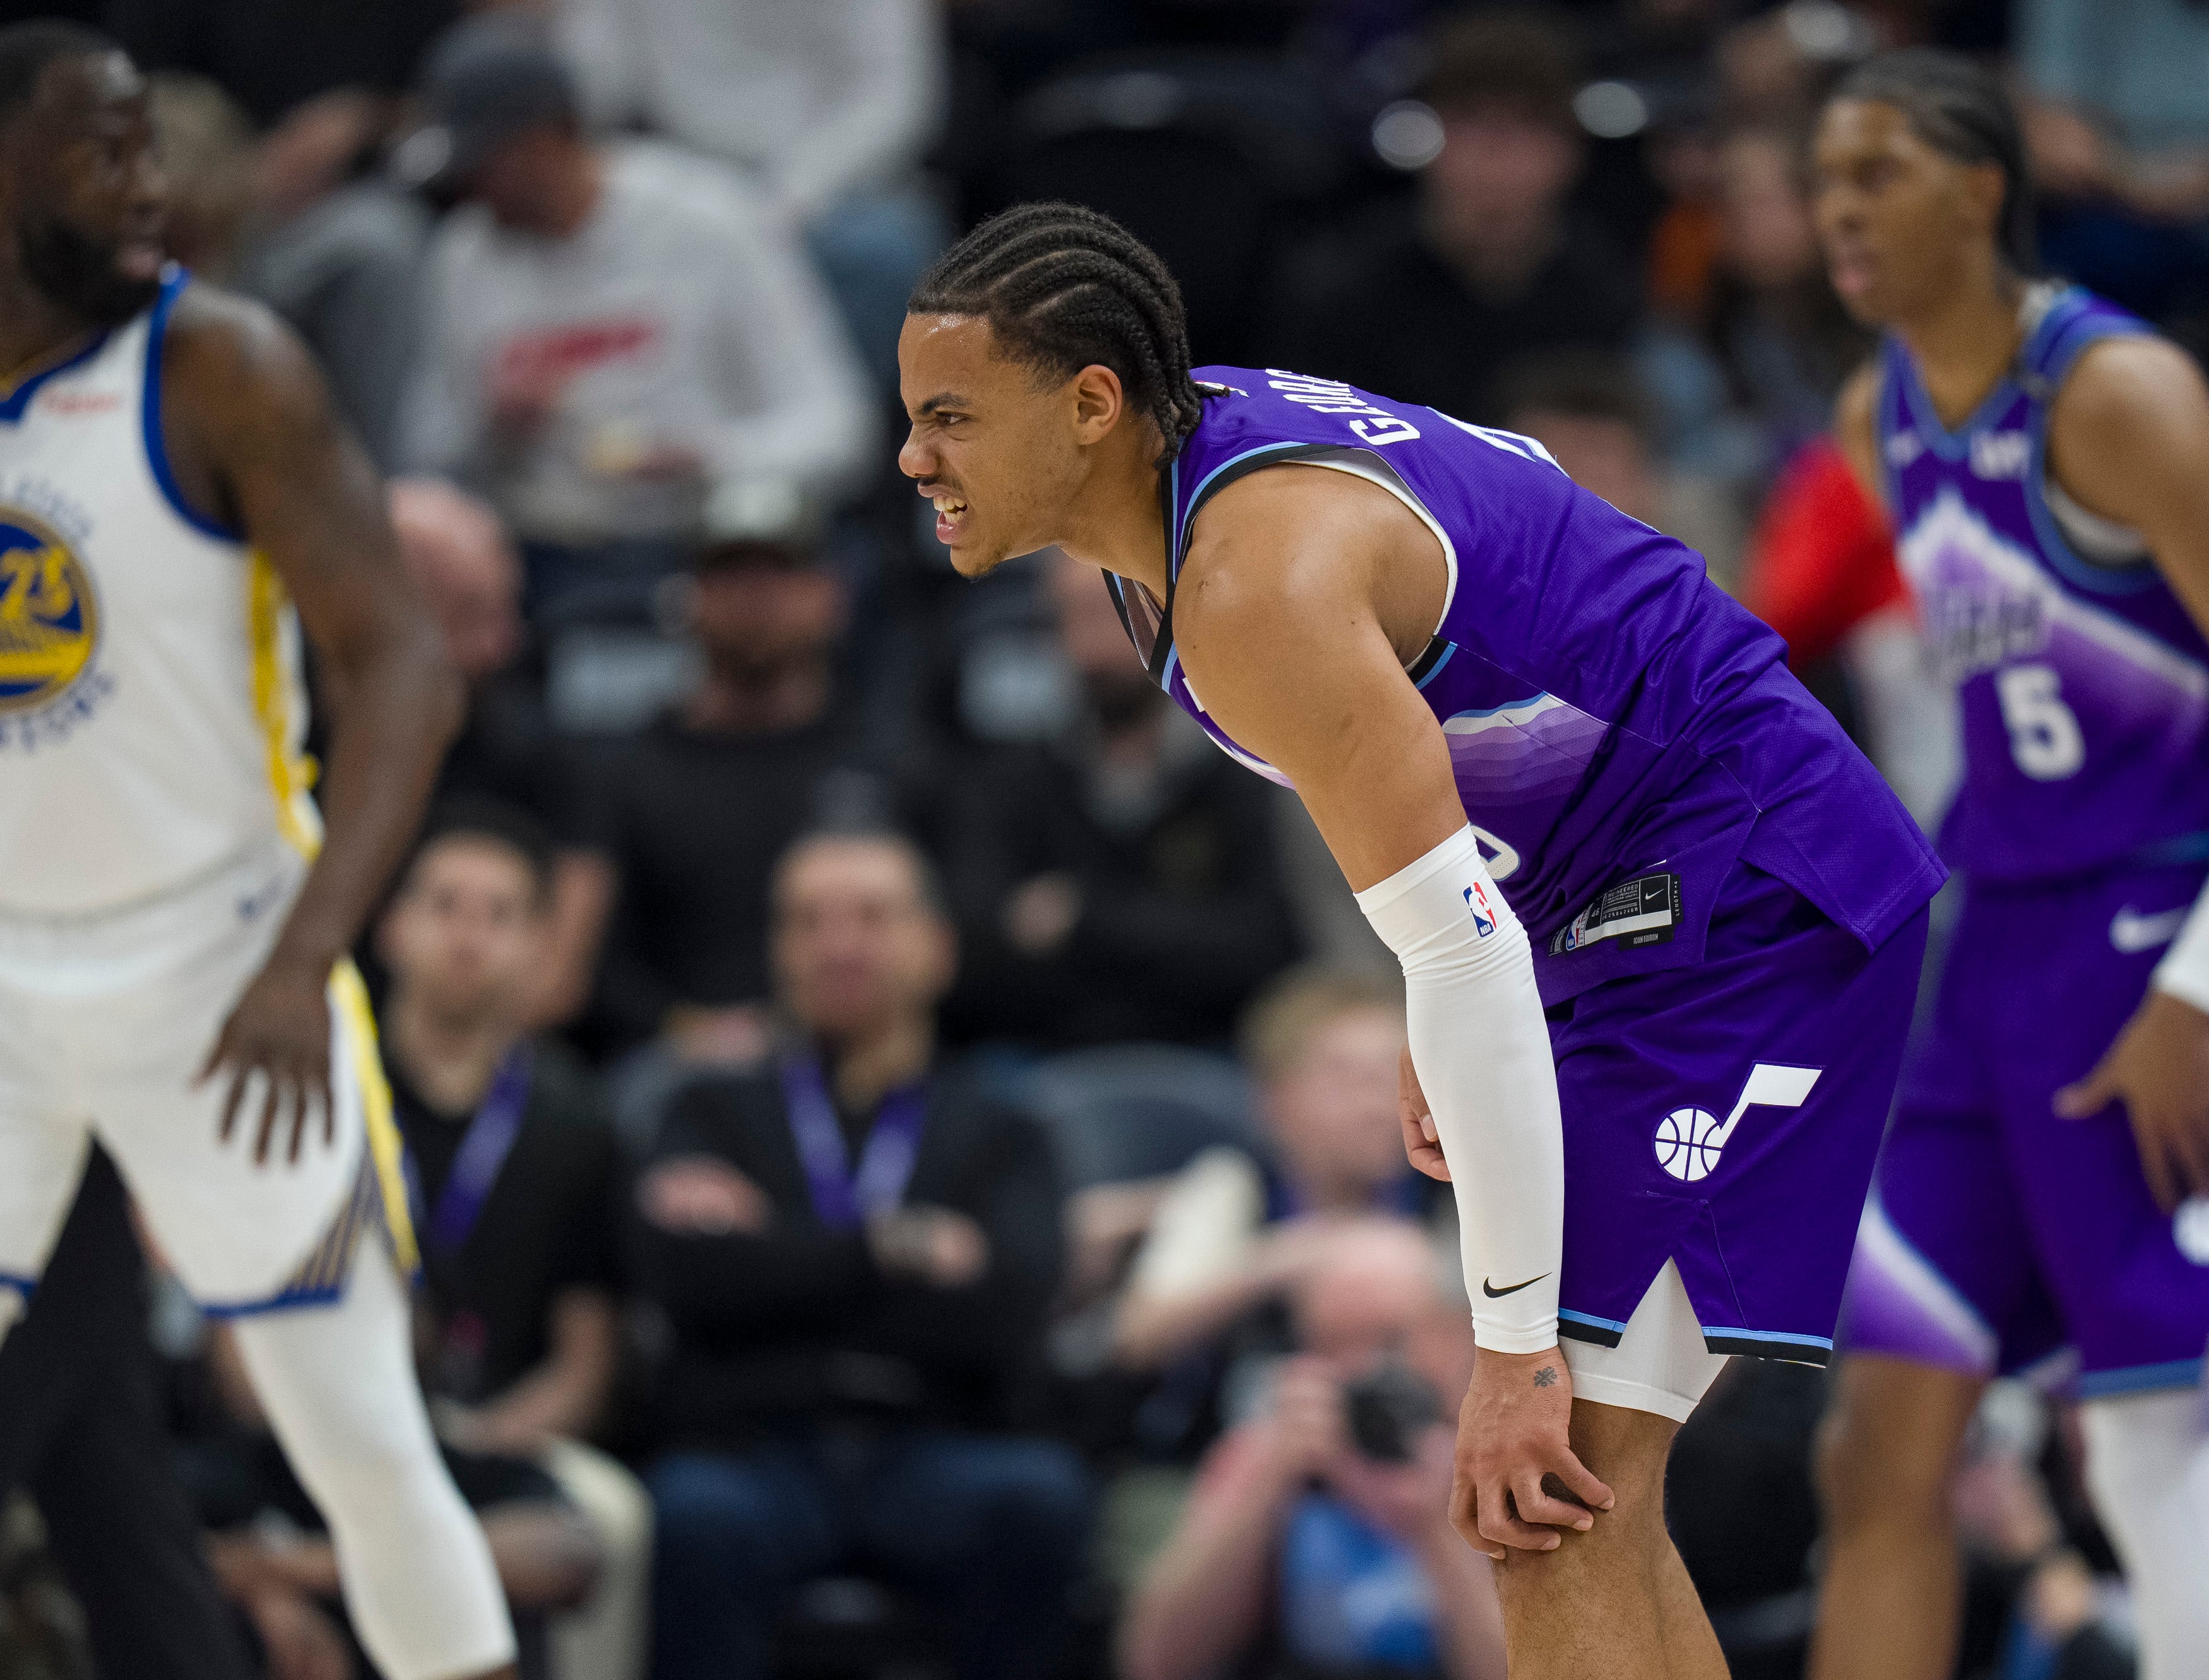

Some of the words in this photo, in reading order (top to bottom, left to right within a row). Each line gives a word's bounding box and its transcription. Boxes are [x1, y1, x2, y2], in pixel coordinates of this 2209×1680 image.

[1996, 663, 2085, 781] 5
[1605, 884, 1638, 899] NGNEERED
[1479, 923, 1491, 936] NBA
[1633, 935, 1643, 945] ICON
[1643, 933, 1659, 942] EDITION
